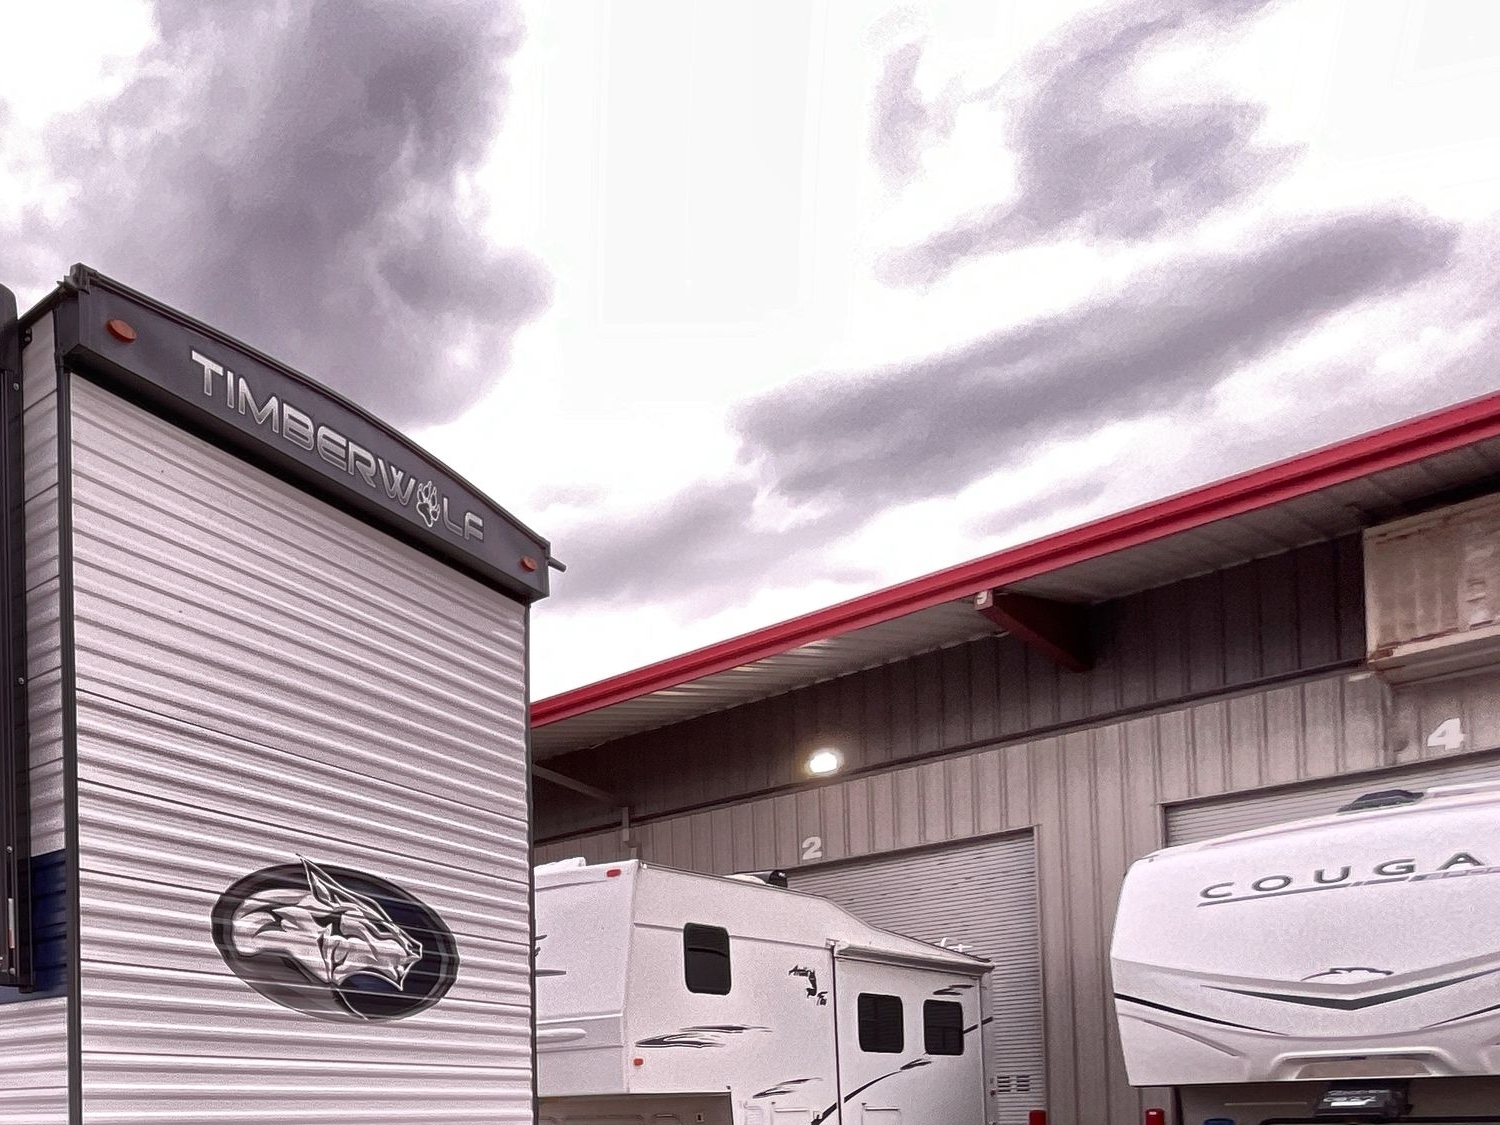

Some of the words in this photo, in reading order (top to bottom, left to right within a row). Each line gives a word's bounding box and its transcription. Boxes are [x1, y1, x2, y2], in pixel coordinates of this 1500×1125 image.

[191, 350, 485, 543] TIMBERWOLF
[1426, 718, 1466, 751] 4
[801, 836, 822, 860] 2
[1199, 851, 1485, 900] COUGA
